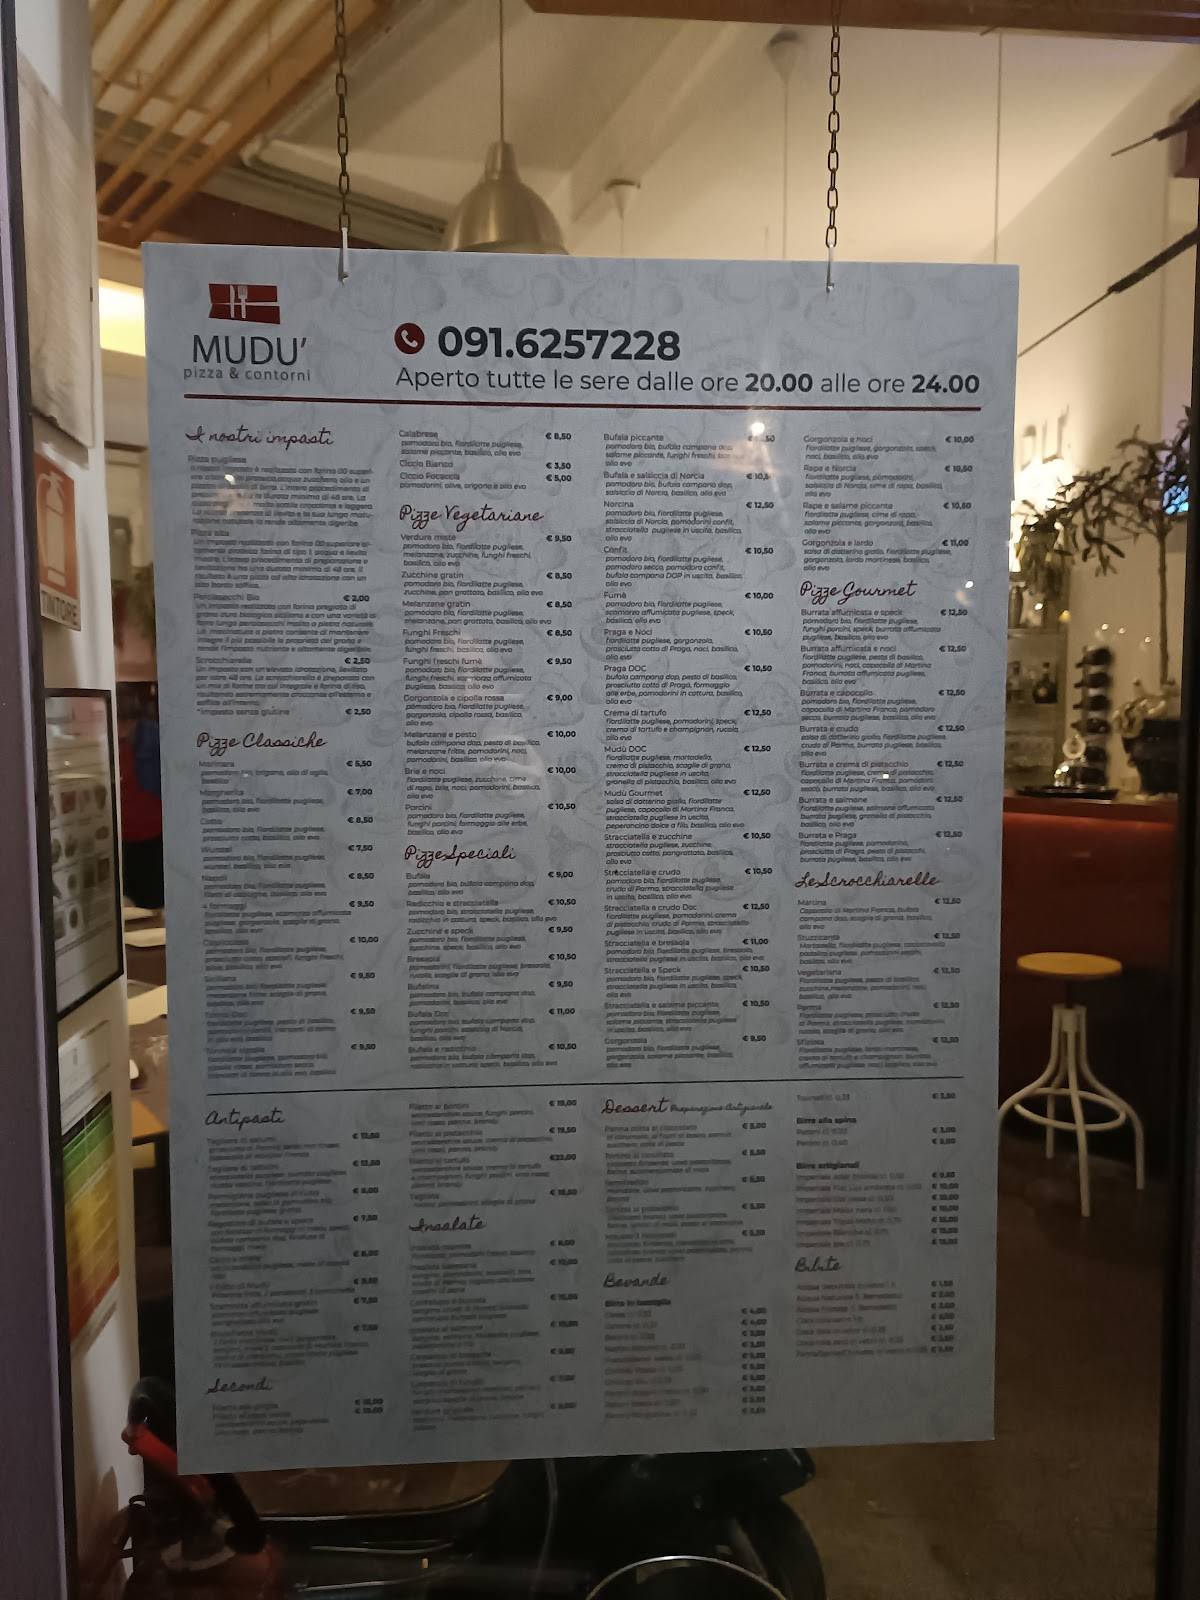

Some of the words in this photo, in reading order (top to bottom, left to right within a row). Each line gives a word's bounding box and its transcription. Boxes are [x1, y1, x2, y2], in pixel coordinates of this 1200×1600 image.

[438, 326, 680, 361] 091.6257228
[193, 335, 306, 366] MUDU'
[184, 366, 223, 380] pizza
[230, 367, 239, 379] &
[245, 370, 310, 382] contorni
[396, 367, 479, 391] Aperto
[487, 371, 545, 389] tutte
[555, 369, 573, 389] le
[581, 375, 629, 390] sere
[637, 371, 693, 391] dalle
[701, 377, 738, 391] ore
[745, 373, 813, 392] 20.00
[821, 373, 860, 392] alle
[868, 378, 904, 393] ore
[912, 374, 979, 393] 24.00
[185, 426, 205, 443] I
[209, 425, 262, 443] nostri
[266, 427, 334, 451] impasti
[630, 434, 664, 443] piccante
[554, 462, 571, 470] 3,50
[400, 505, 442, 529] Pizze
[445, 504, 544, 532] Vegetariane
[440, 572, 463, 581] gratin
[800, 581, 842, 605] Pizze
[836, 580, 917, 605] Gourmet
[447, 601, 470, 609] gratin
[403, 629, 430, 638] Funghi
[604, 629, 626, 637] Praga
[402, 657, 431, 667] Funghi
[604, 665, 626, 674] Praga
[641, 709, 666, 717] tartufo
[752, 709, 771, 717] 12,50
[456, 732, 477, 740] pesto
[197, 732, 240, 756] Pizze
[243, 731, 328, 748] Classiche
[355, 760, 372, 768] 5,50
[556, 767, 576, 775] 10,00
[605, 834, 650, 842] Stracciatella
[799, 832, 826, 840] Burrata
[835, 832, 856, 840] Praga
[405, 845, 445, 868] Pizze
[440, 845, 516, 866] Speciali
[795, 872, 819, 888] Le
[814, 871, 940, 888] Scrocchiarelle
[451, 928, 473, 936] speck
[601, 1097, 670, 1114] Dessert
[205, 1107, 285, 1131] Antipasti
[409, 1214, 487, 1232] Insalate
[603, 1273, 668, 1288] Bevande
[206, 1377, 272, 1395] Secondi
